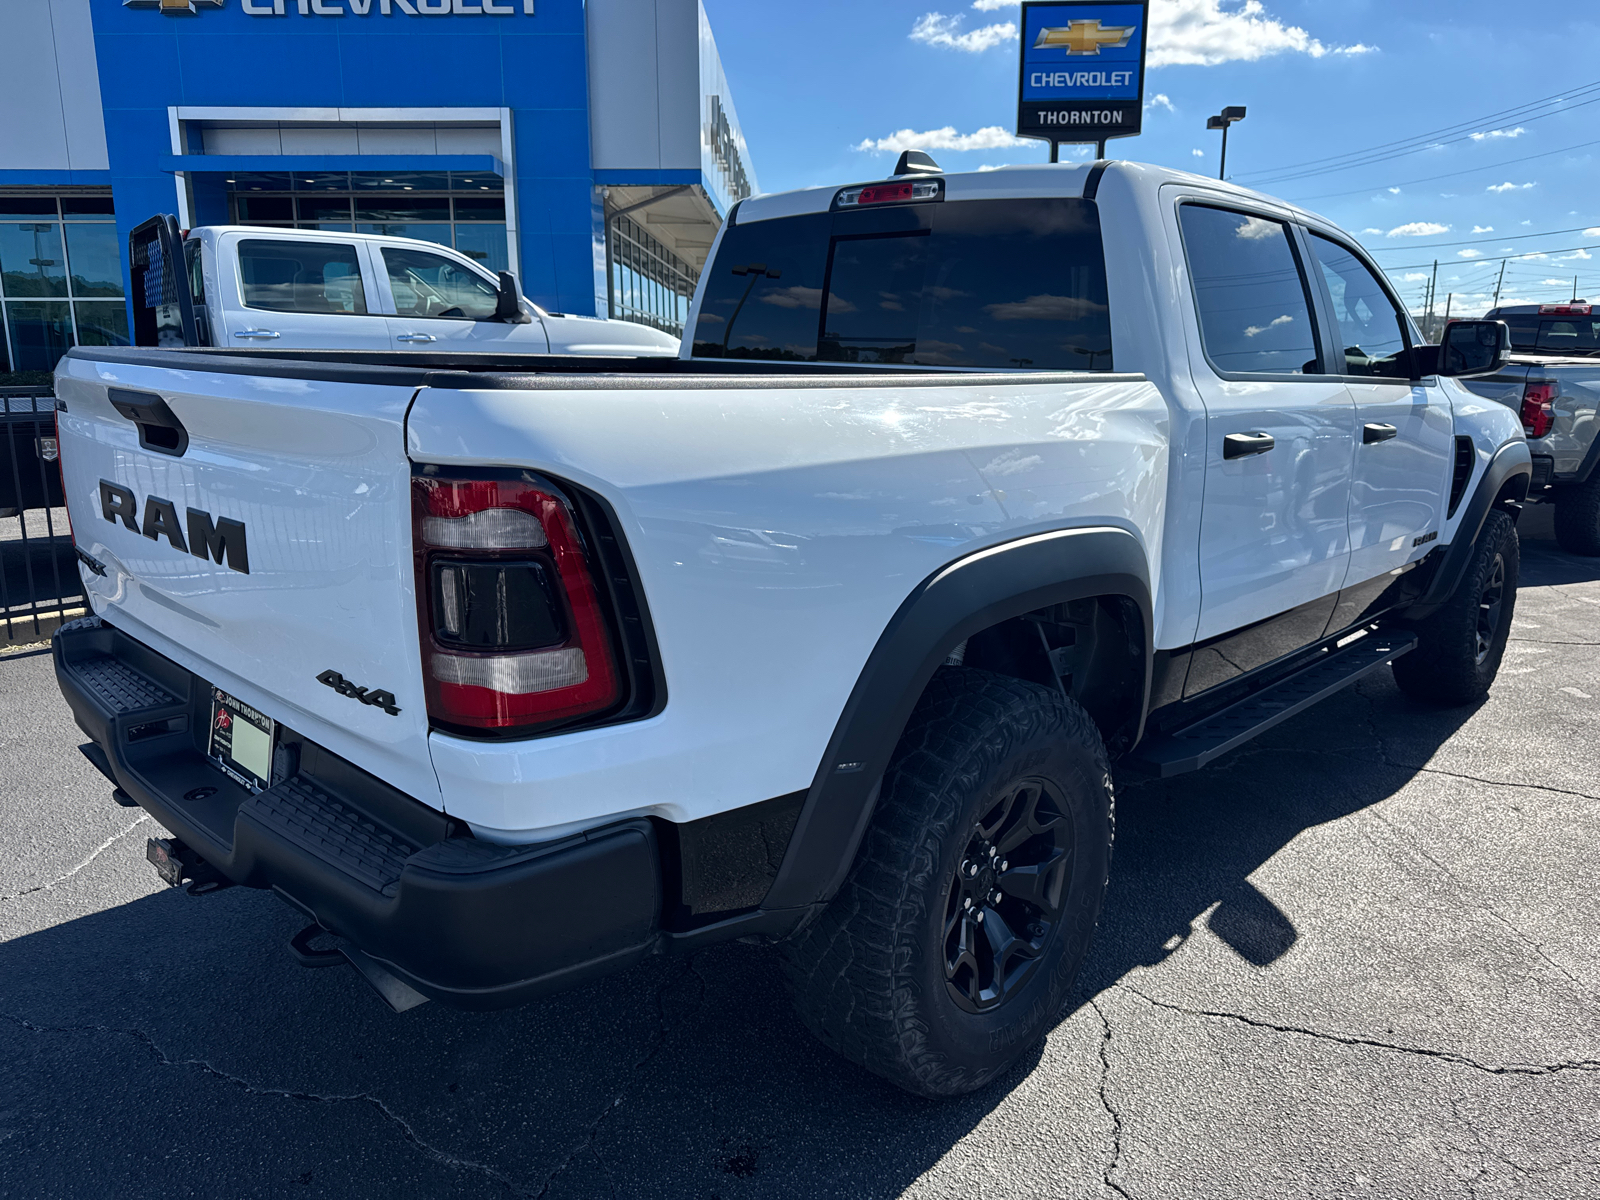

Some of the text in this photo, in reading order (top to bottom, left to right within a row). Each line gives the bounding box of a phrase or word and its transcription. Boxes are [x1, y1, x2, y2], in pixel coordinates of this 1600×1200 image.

[1030, 70, 1133, 87] CHEVROLET
[1038, 110, 1123, 124] THORNTON
[98, 478, 250, 575] RAM
[1412, 530, 1438, 548] RAM
[225, 694, 241, 712] JOHN
[240, 703, 271, 730] THORNTON
[988, 885, 1097, 1055] GOODYEAR
